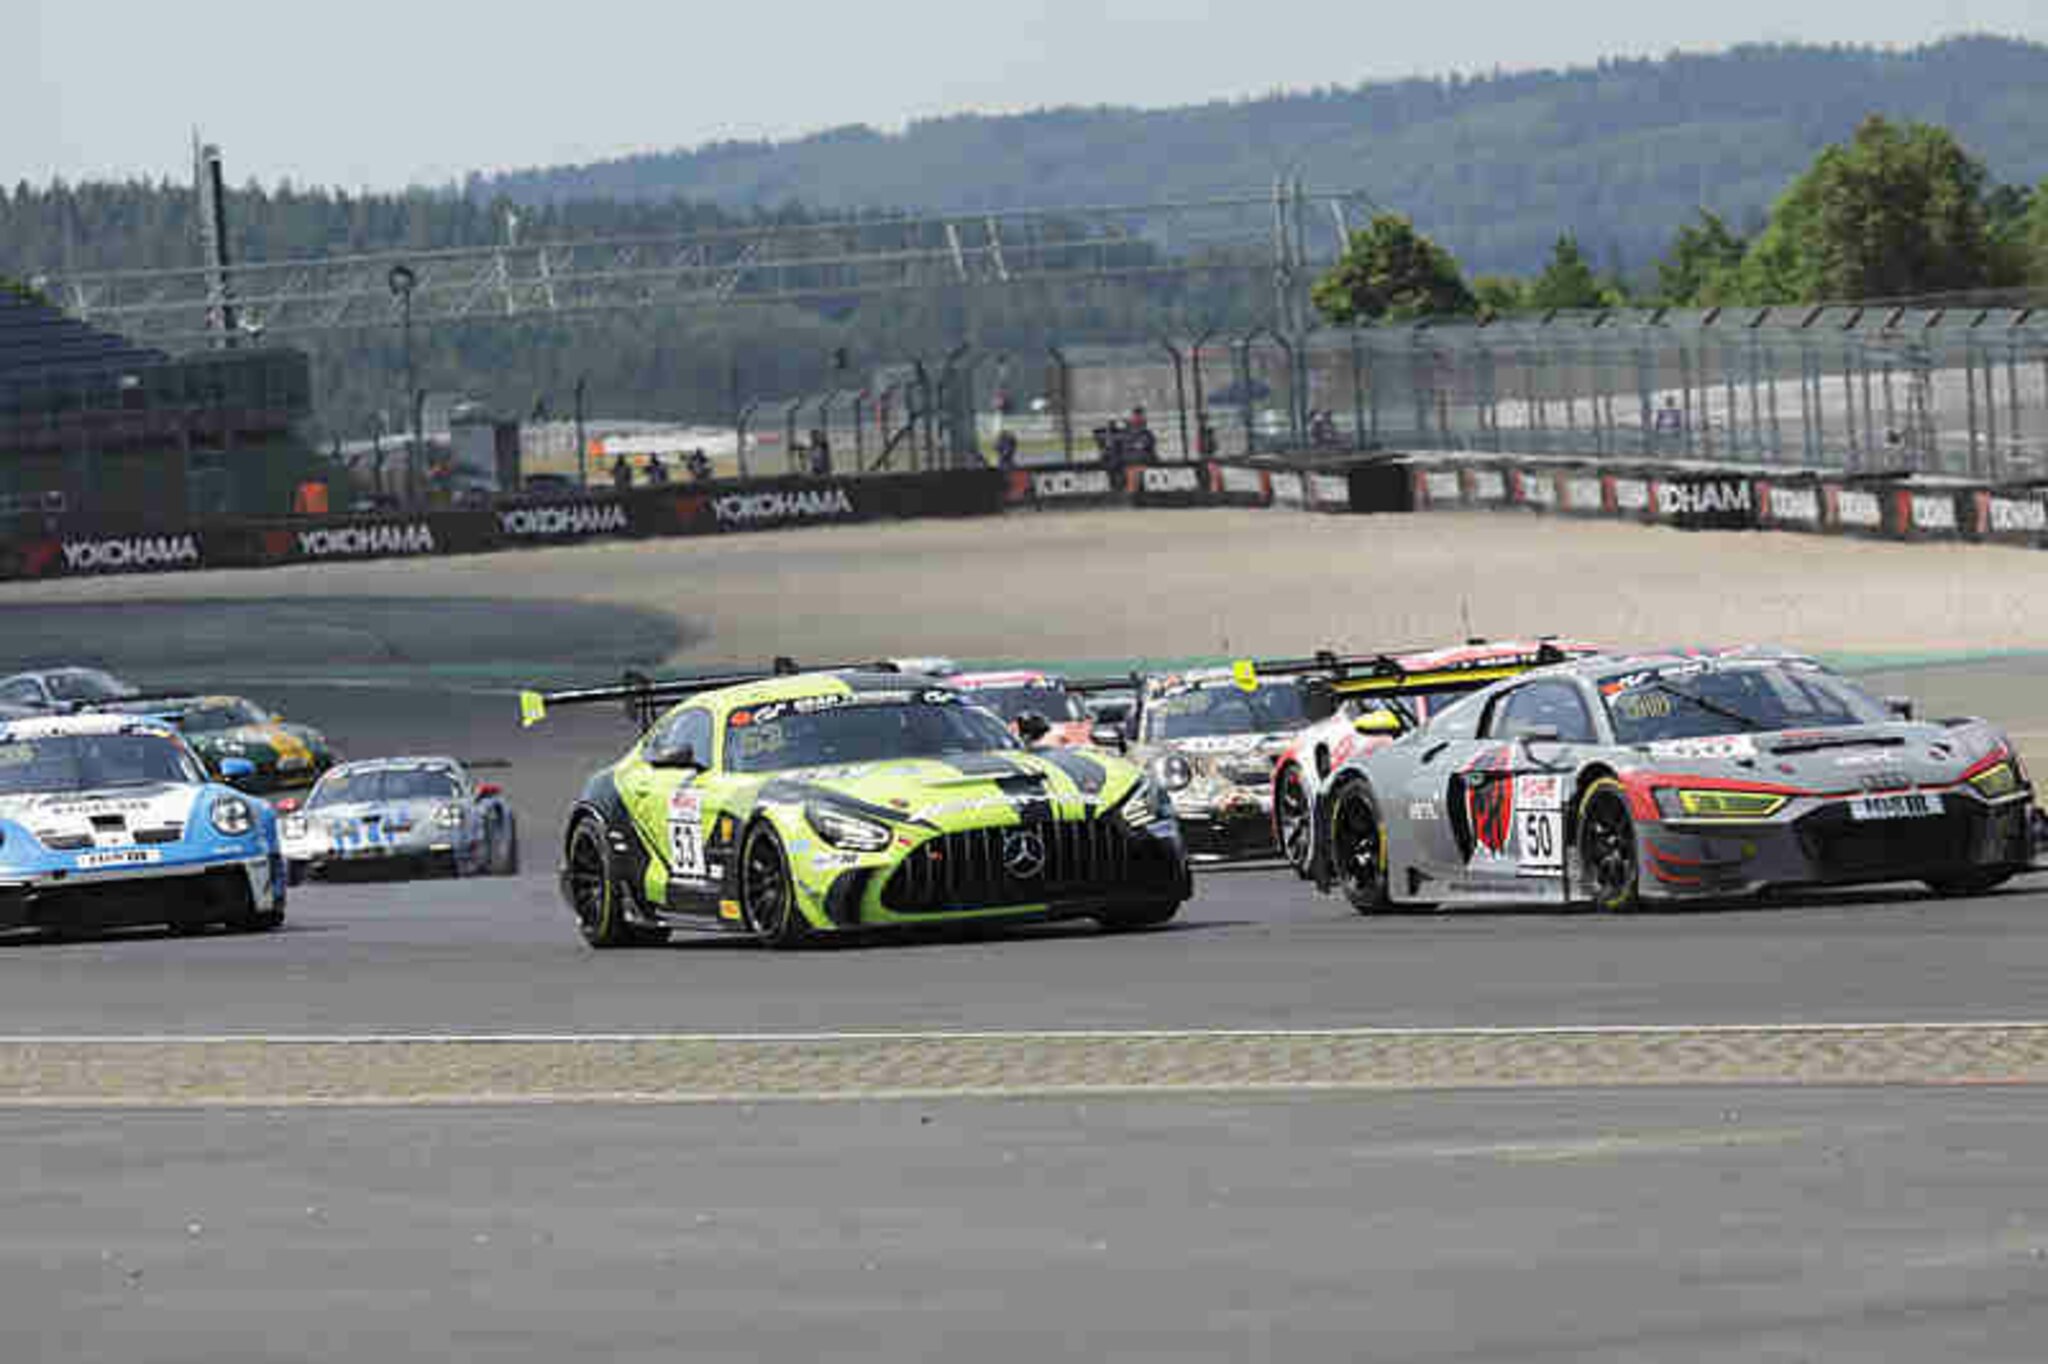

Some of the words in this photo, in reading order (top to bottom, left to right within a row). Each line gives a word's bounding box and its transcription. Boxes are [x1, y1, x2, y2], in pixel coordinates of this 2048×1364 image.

[501, 507, 627, 533] YOKOHAMA
[713, 488, 852, 521] YOKOHAMA
[62, 534, 198, 567] YOKOHAMA
[301, 523, 435, 554] YOKOHAMA
[1526, 813, 1552, 858] 50
